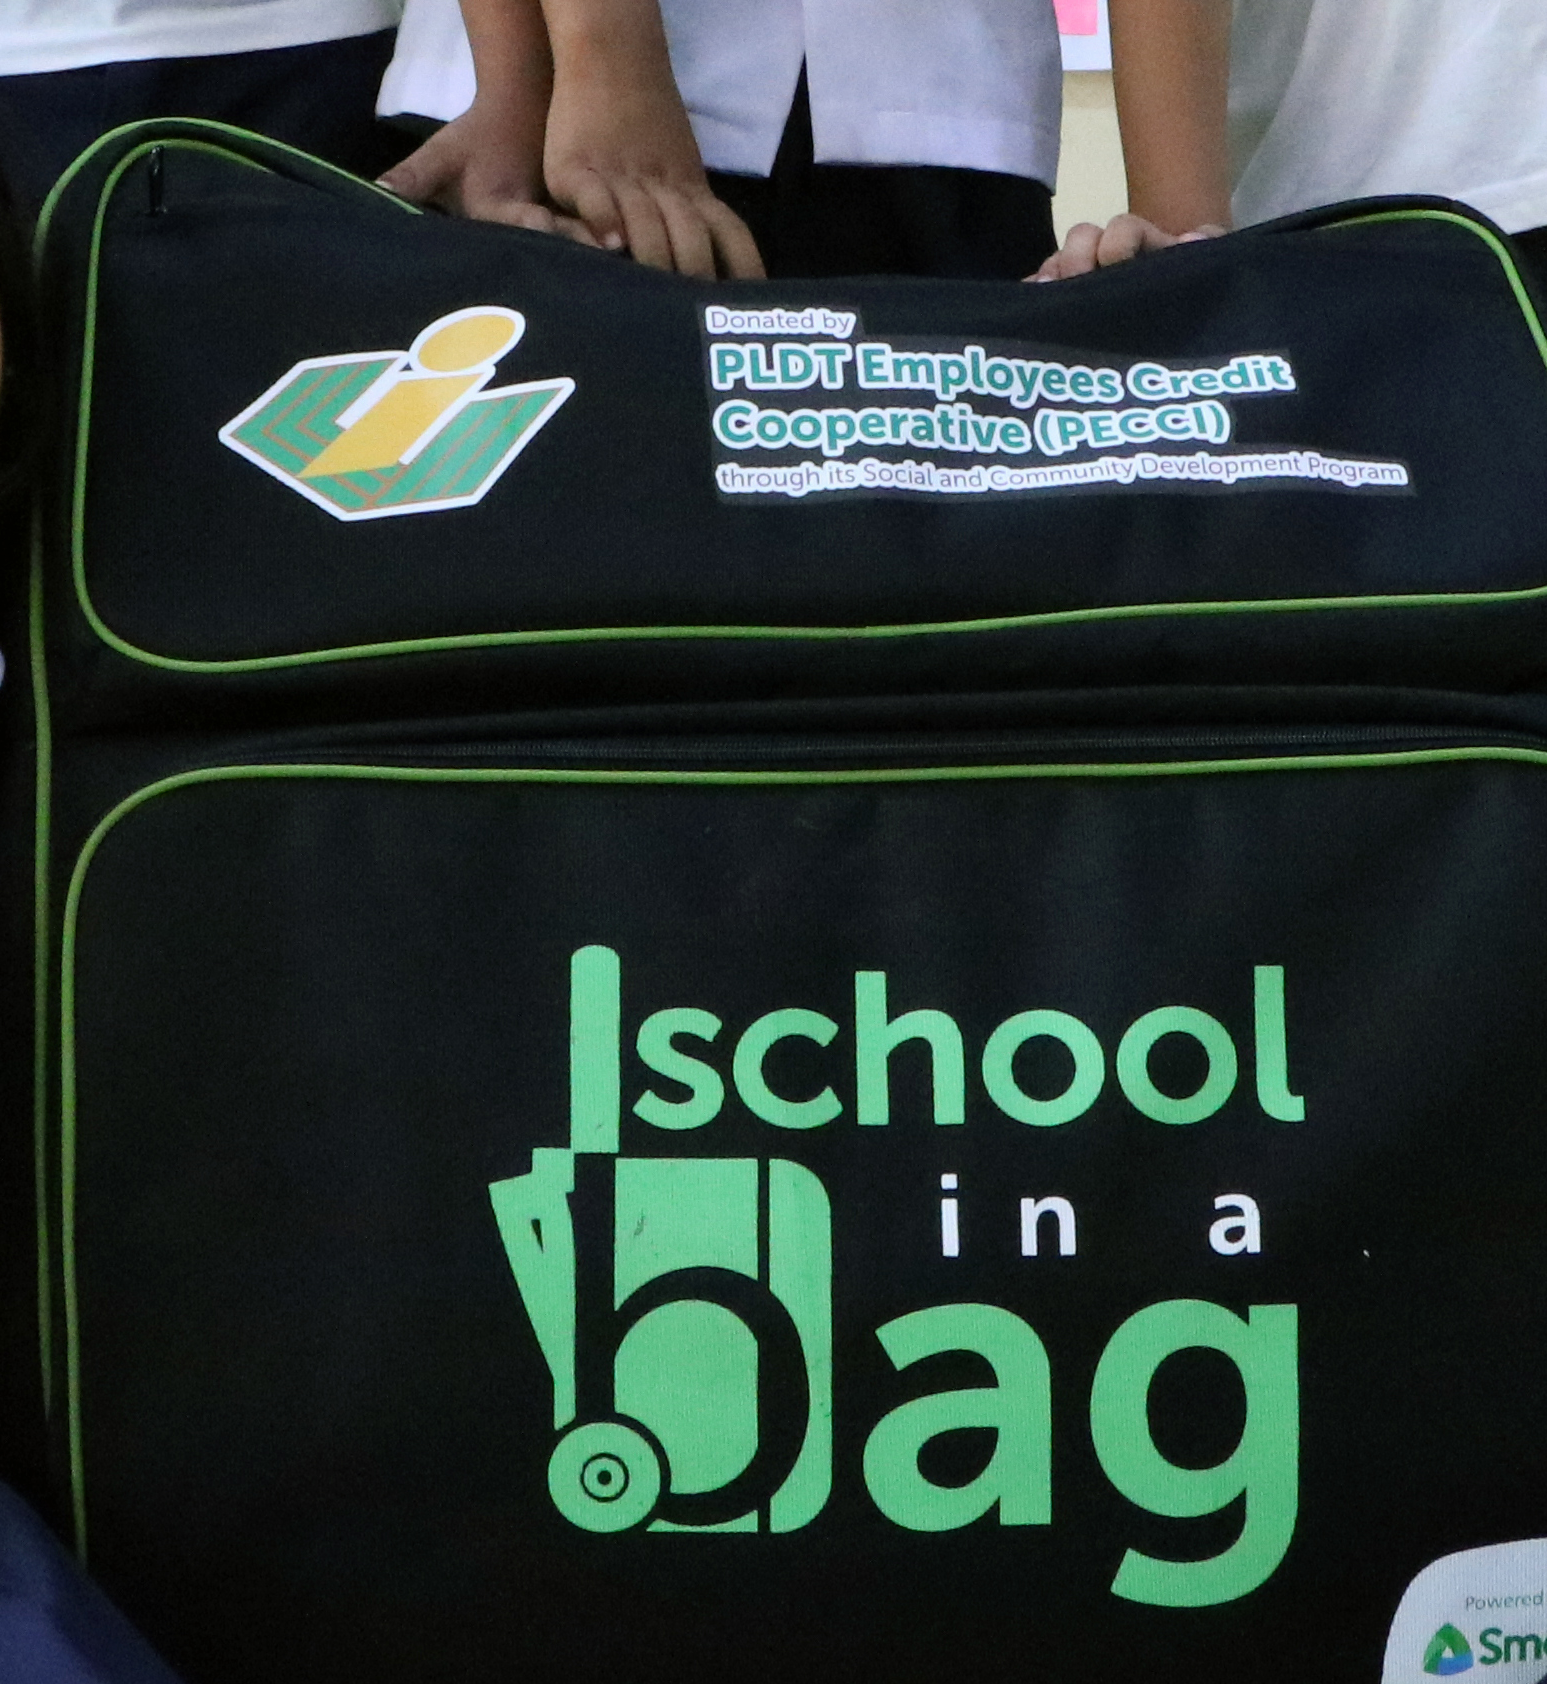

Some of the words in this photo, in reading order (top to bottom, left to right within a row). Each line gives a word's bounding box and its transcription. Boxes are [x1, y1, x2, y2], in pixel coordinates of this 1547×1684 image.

[710, 310, 815, 330] Donated
[822, 312, 851, 333] by
[715, 347, 847, 385] PLDT
[859, 348, 1119, 403] Employees
[1132, 359, 1291, 396] Credit
[718, 404, 1026, 452] Cooperative
[1038, 403, 1225, 452] (PECCI)
[720, 466, 820, 492] through
[828, 464, 856, 484] its
[863, 463, 934, 486] Social
[940, 467, 982, 487] and
[990, 458, 1134, 487] Community
[1141, 455, 1301, 481] Development
[1309, 456, 1404, 483] Program
[632, 963, 1306, 1131] school
[939, 1173, 1077, 1258] in
[1207, 1191, 1262, 1257] a
[1465, 1588, 1544, 1611] Powered
